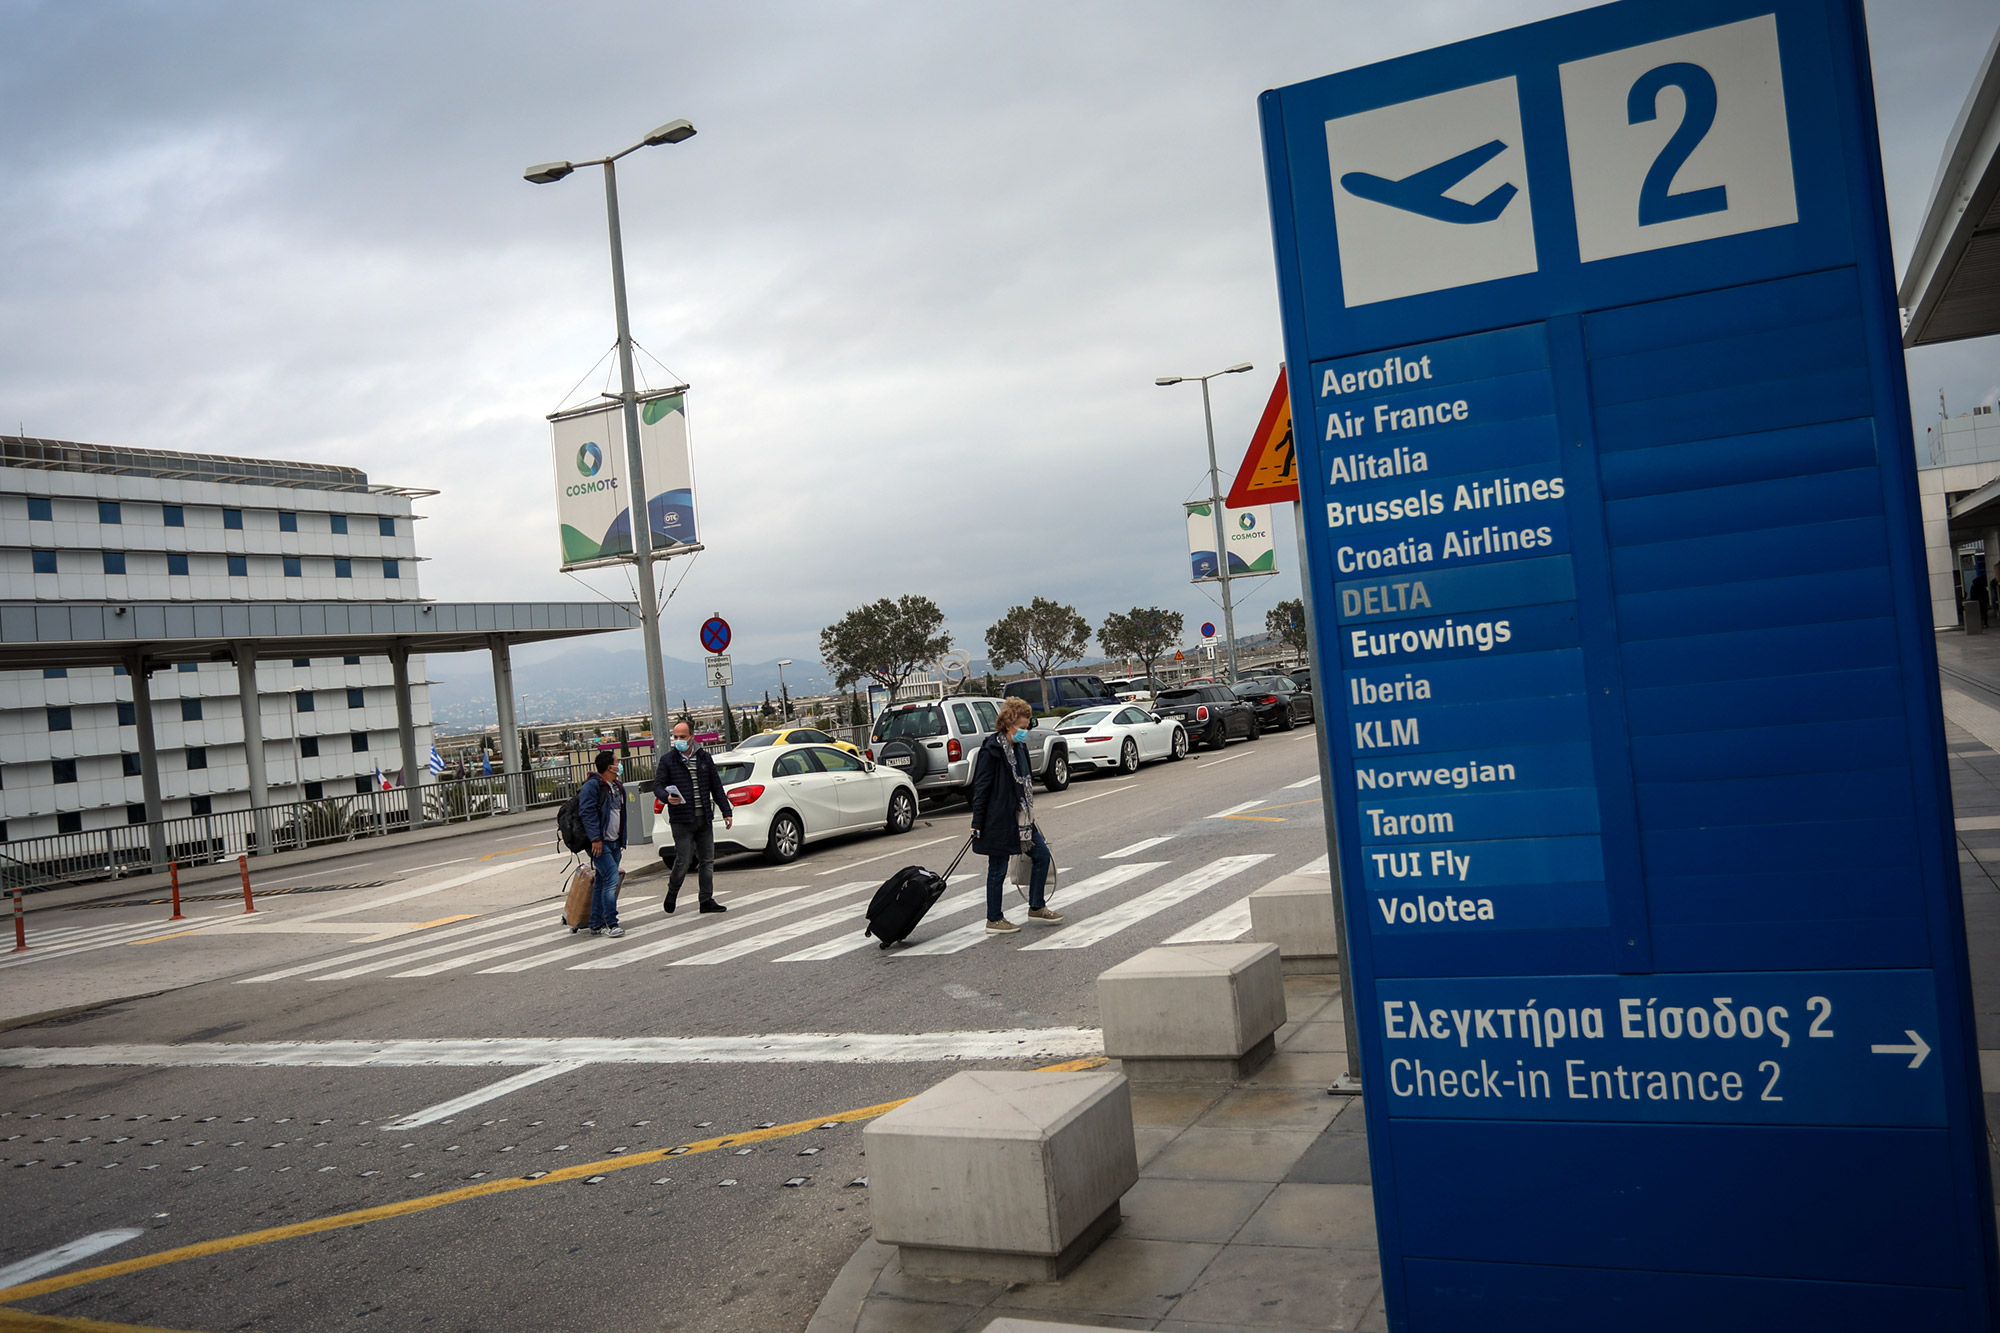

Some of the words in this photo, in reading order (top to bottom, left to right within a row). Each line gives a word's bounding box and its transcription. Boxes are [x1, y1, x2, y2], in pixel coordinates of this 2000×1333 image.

[1627, 62, 1728, 227] 2
[1321, 355, 1433, 398] Aeroflot
[1325, 410, 1365, 441] Air
[1373, 399, 1469, 433] France
[1330, 446, 1428, 485] Alitalia
[1326, 489, 1445, 528] Brussels
[1453, 477, 1565, 512] Airlines
[1337, 537, 1434, 573] Croatia
[1442, 525, 1553, 559] Airlines
[1342, 581, 1431, 617] DELTA
[1351, 619, 1512, 658] Eurowings
[1350, 673, 1431, 705] Iberia
[1355, 717, 1420, 749] KLM
[1356, 761, 1516, 790] Norwegian
[1366, 808, 1454, 837] Tarom
[1371, 852, 1422, 879] TUI
[1430, 849, 1471, 882] Fly
[1377, 895, 1495, 925] Volotea
[1383, 999, 1604, 1048] Ελεγκτήρια
[1619, 997, 1790, 1048] Είσοδος
[1806, 996, 1834, 1038] 2
[1390, 1058, 1551, 1098] Check-in
[1565, 1059, 1743, 1101] Entrance
[1758, 1060, 1783, 1101] 2
